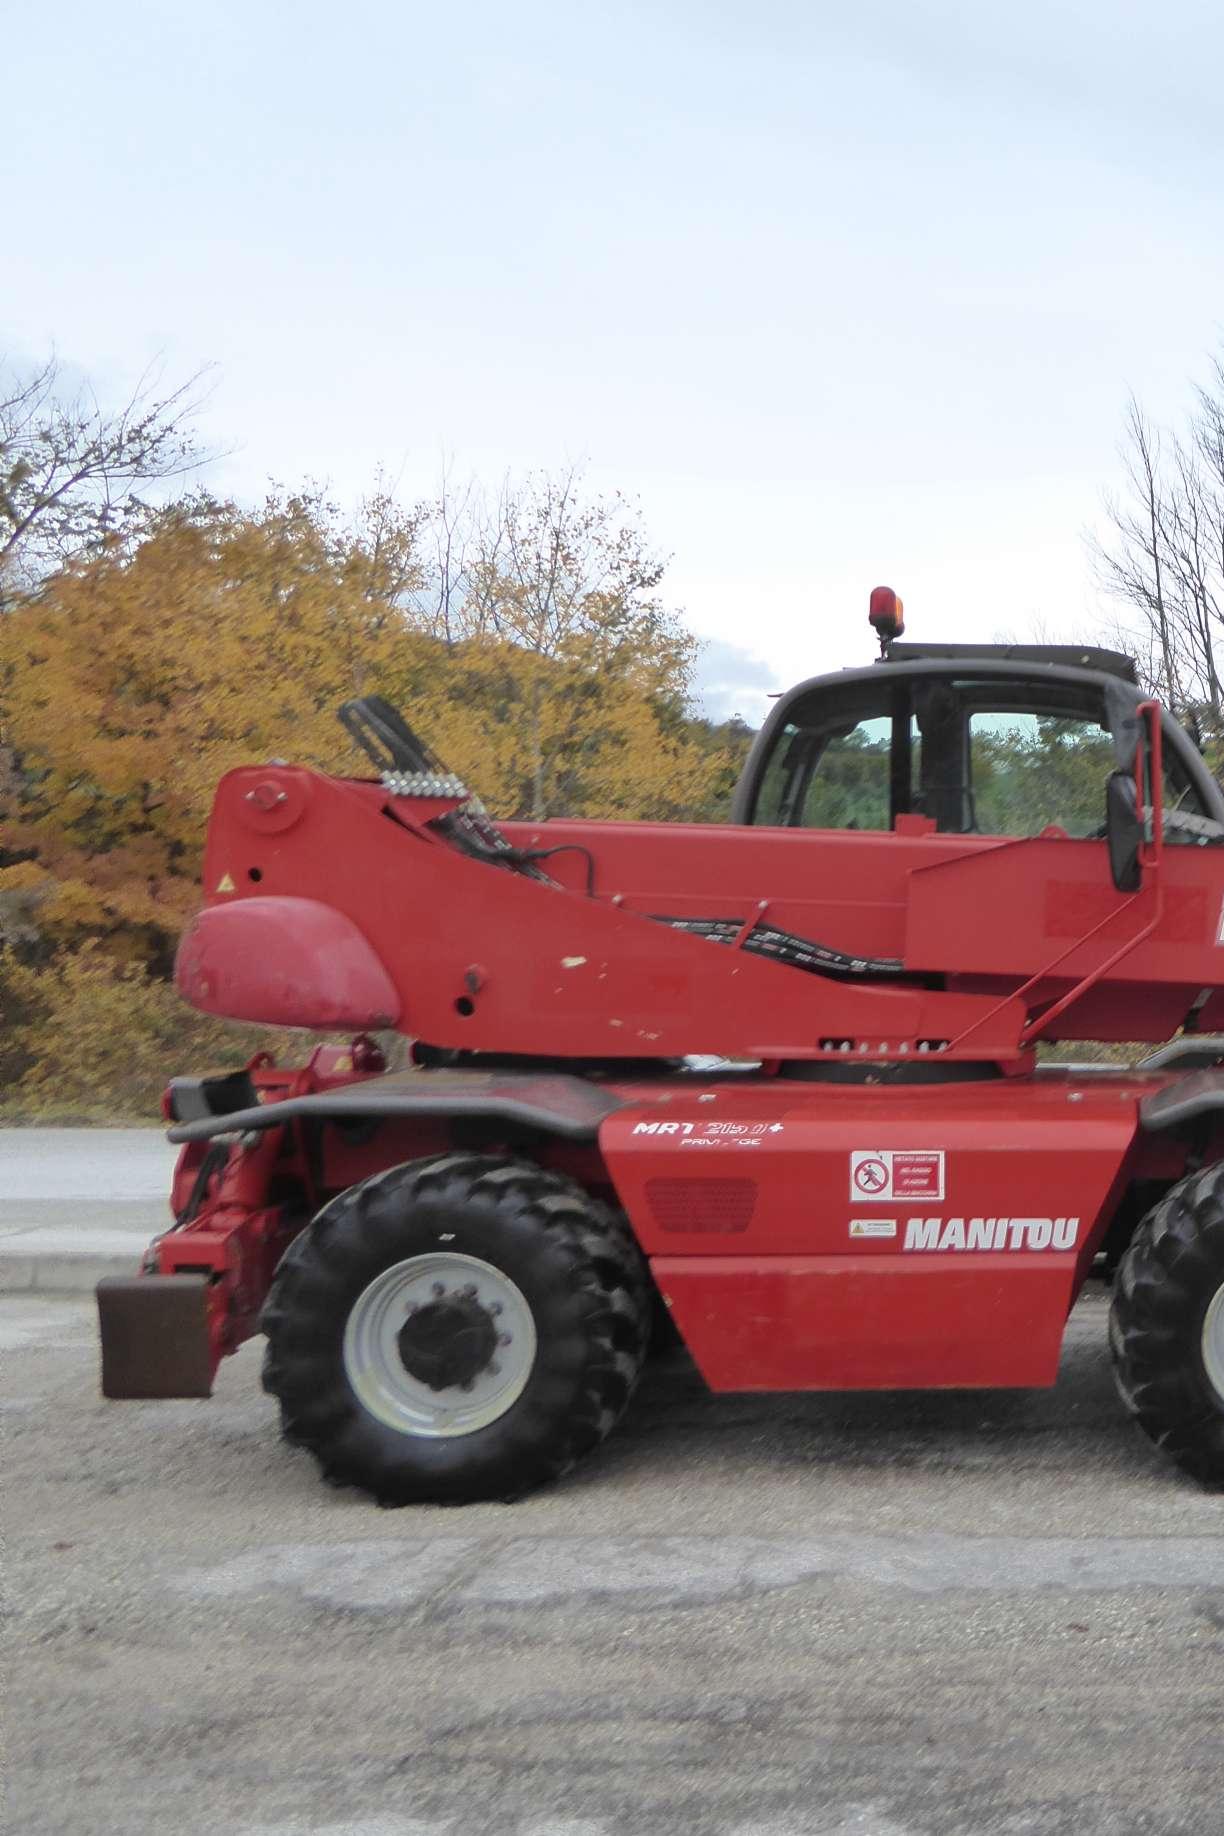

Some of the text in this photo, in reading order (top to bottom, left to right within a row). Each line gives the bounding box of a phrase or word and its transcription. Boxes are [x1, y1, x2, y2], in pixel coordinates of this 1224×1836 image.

[632, 1122, 695, 1135] MRT
[681, 1138, 762, 1146] PRIVGE
[903, 1217, 1080, 1250] MANITOU
